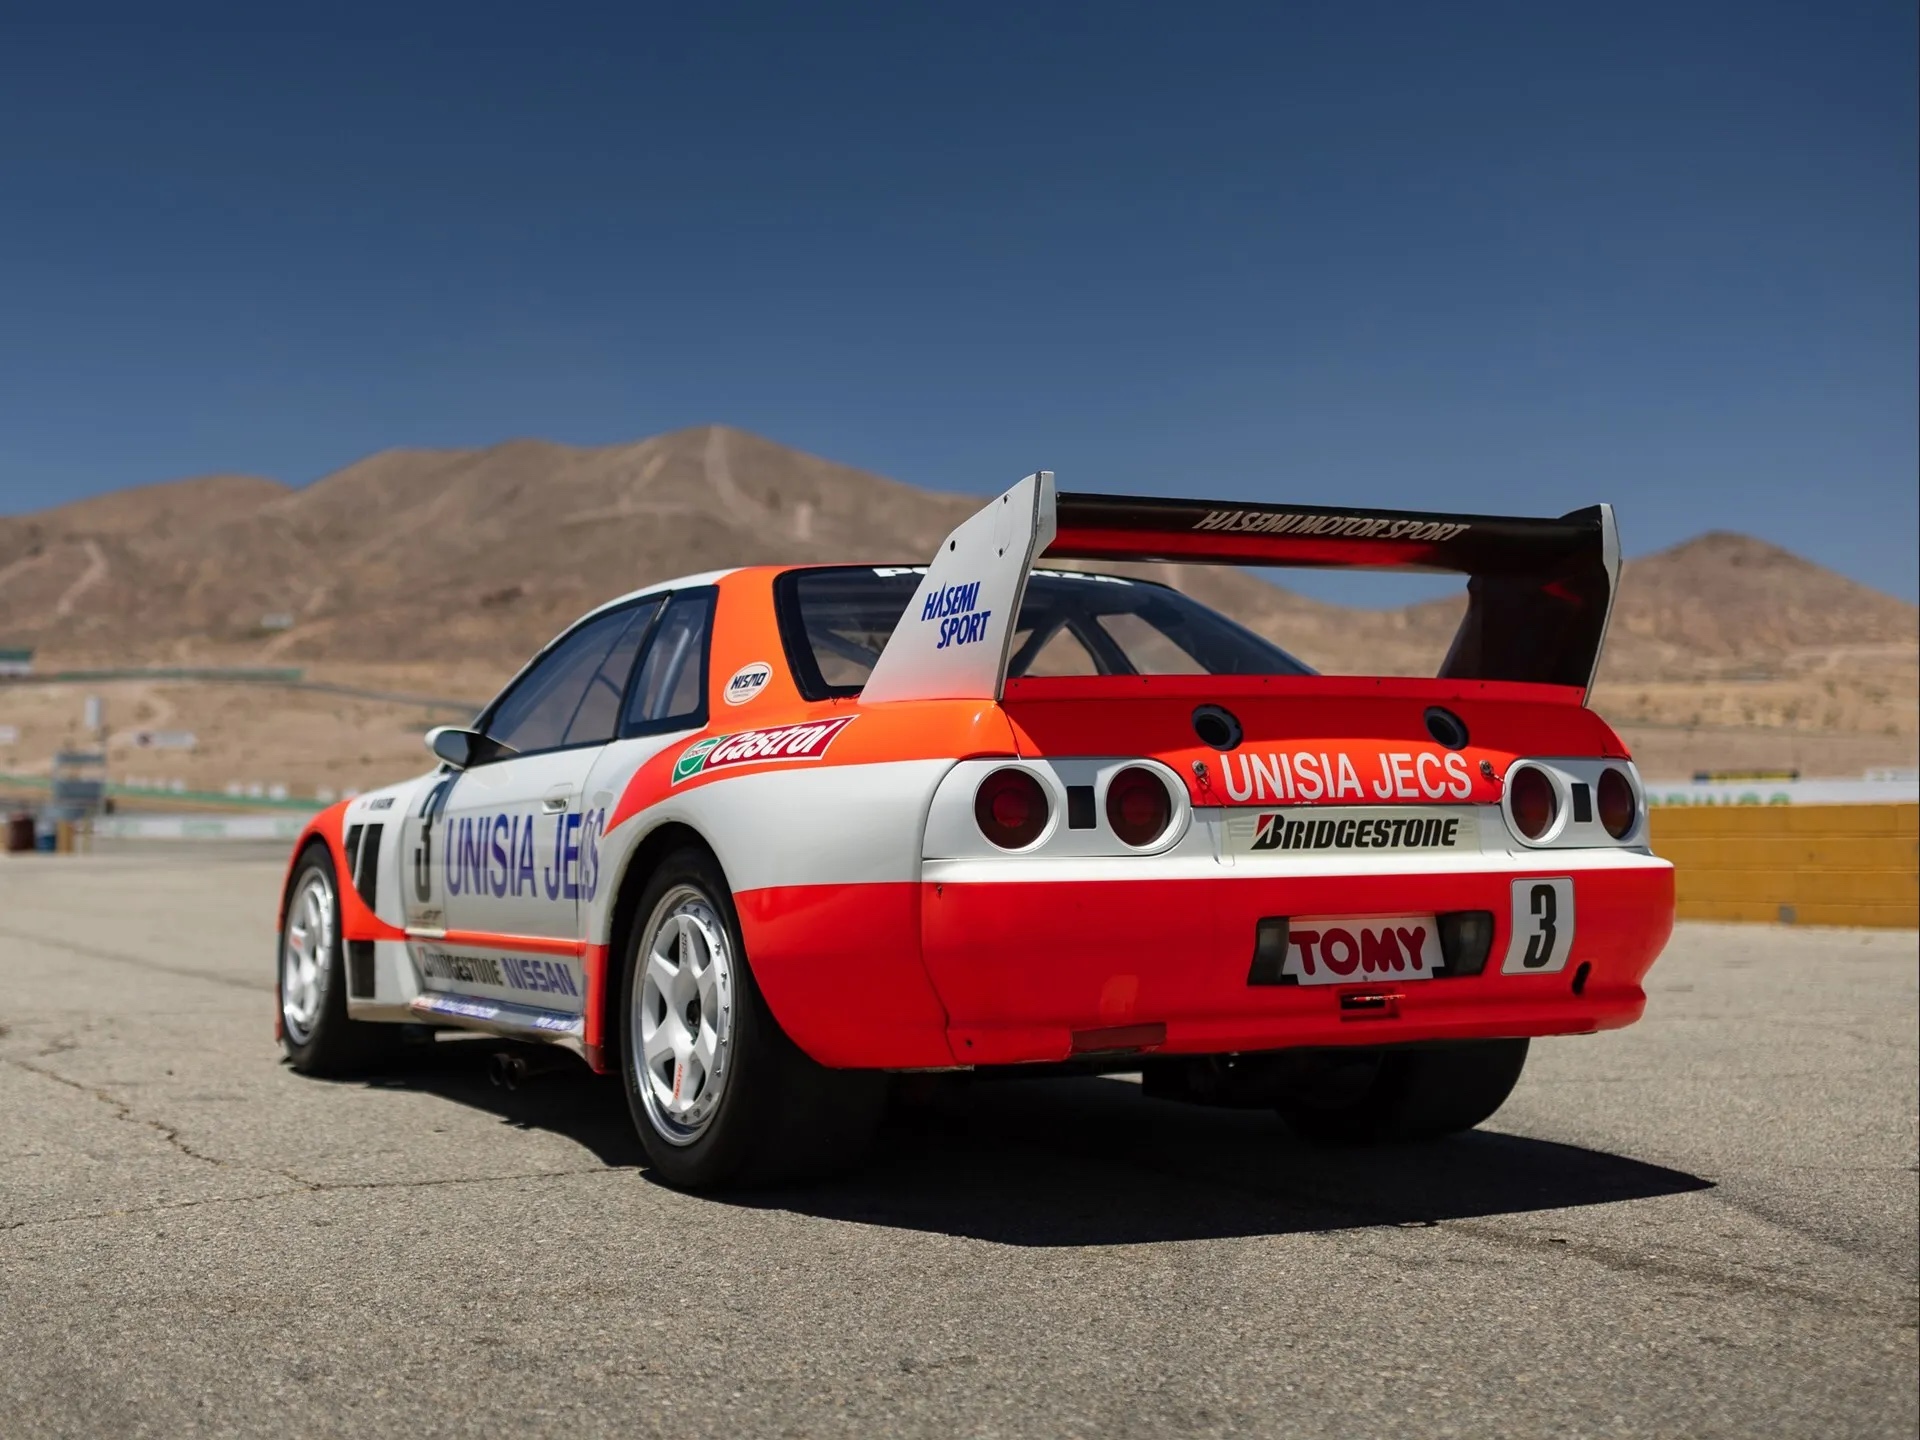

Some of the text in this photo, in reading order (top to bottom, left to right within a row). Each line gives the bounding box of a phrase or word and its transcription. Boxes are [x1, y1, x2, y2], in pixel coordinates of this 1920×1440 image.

[1192, 510, 1304, 534] HASEMI
[921, 581, 981, 622] HASEMI
[936, 610, 991, 650] SPORT
[730, 671, 768, 691] NISMO
[710, 719, 846, 764] Castrol
[1219, 751, 1473, 802] UNISIA JECS
[415, 780, 449, 904] 3
[1250, 814, 1460, 851] BRIDGESTONE
[445, 813, 538, 899] UNISIA
[1522, 884, 1557, 969] 3
[1288, 926, 1427, 976] TOMY
[501, 957, 579, 997] NISSAN
